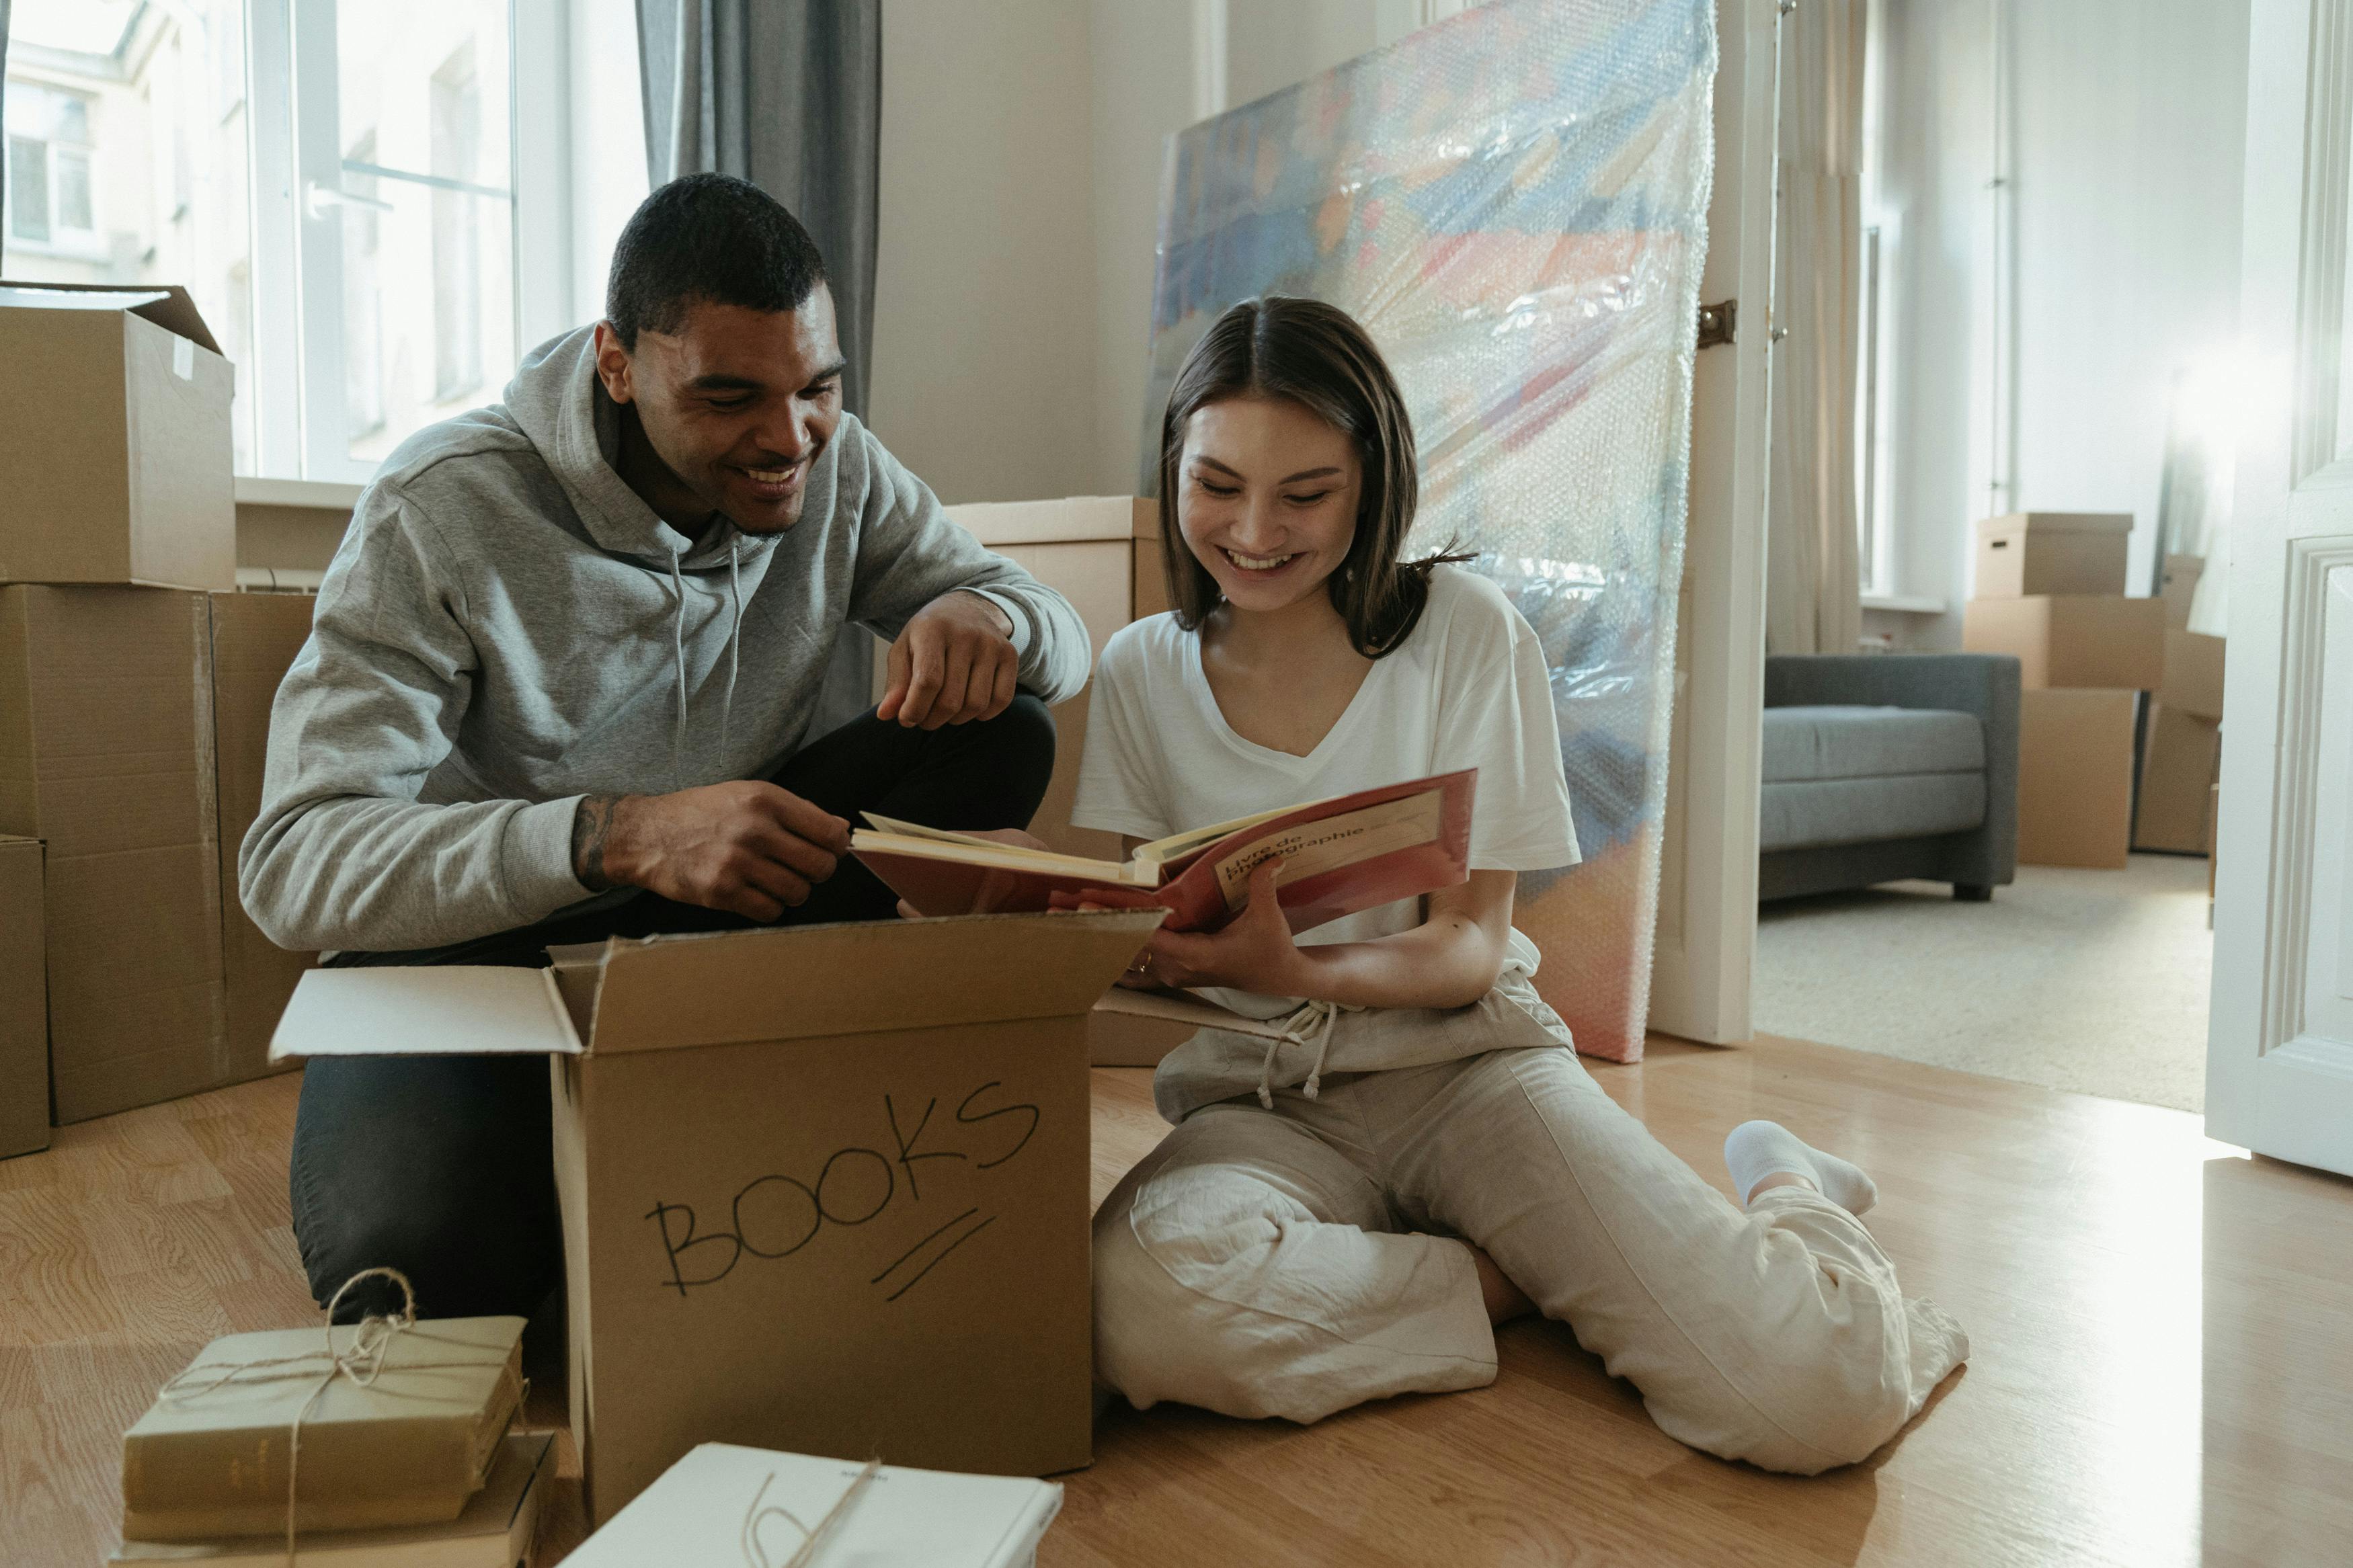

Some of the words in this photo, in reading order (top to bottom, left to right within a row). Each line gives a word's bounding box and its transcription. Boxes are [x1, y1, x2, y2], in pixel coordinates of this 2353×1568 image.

[1226, 846, 1271, 873] Livre
[1276, 836, 1302, 847] de
[1227, 828, 1364, 880] photographie
[645, 1080, 1039, 1296] BOOKS
